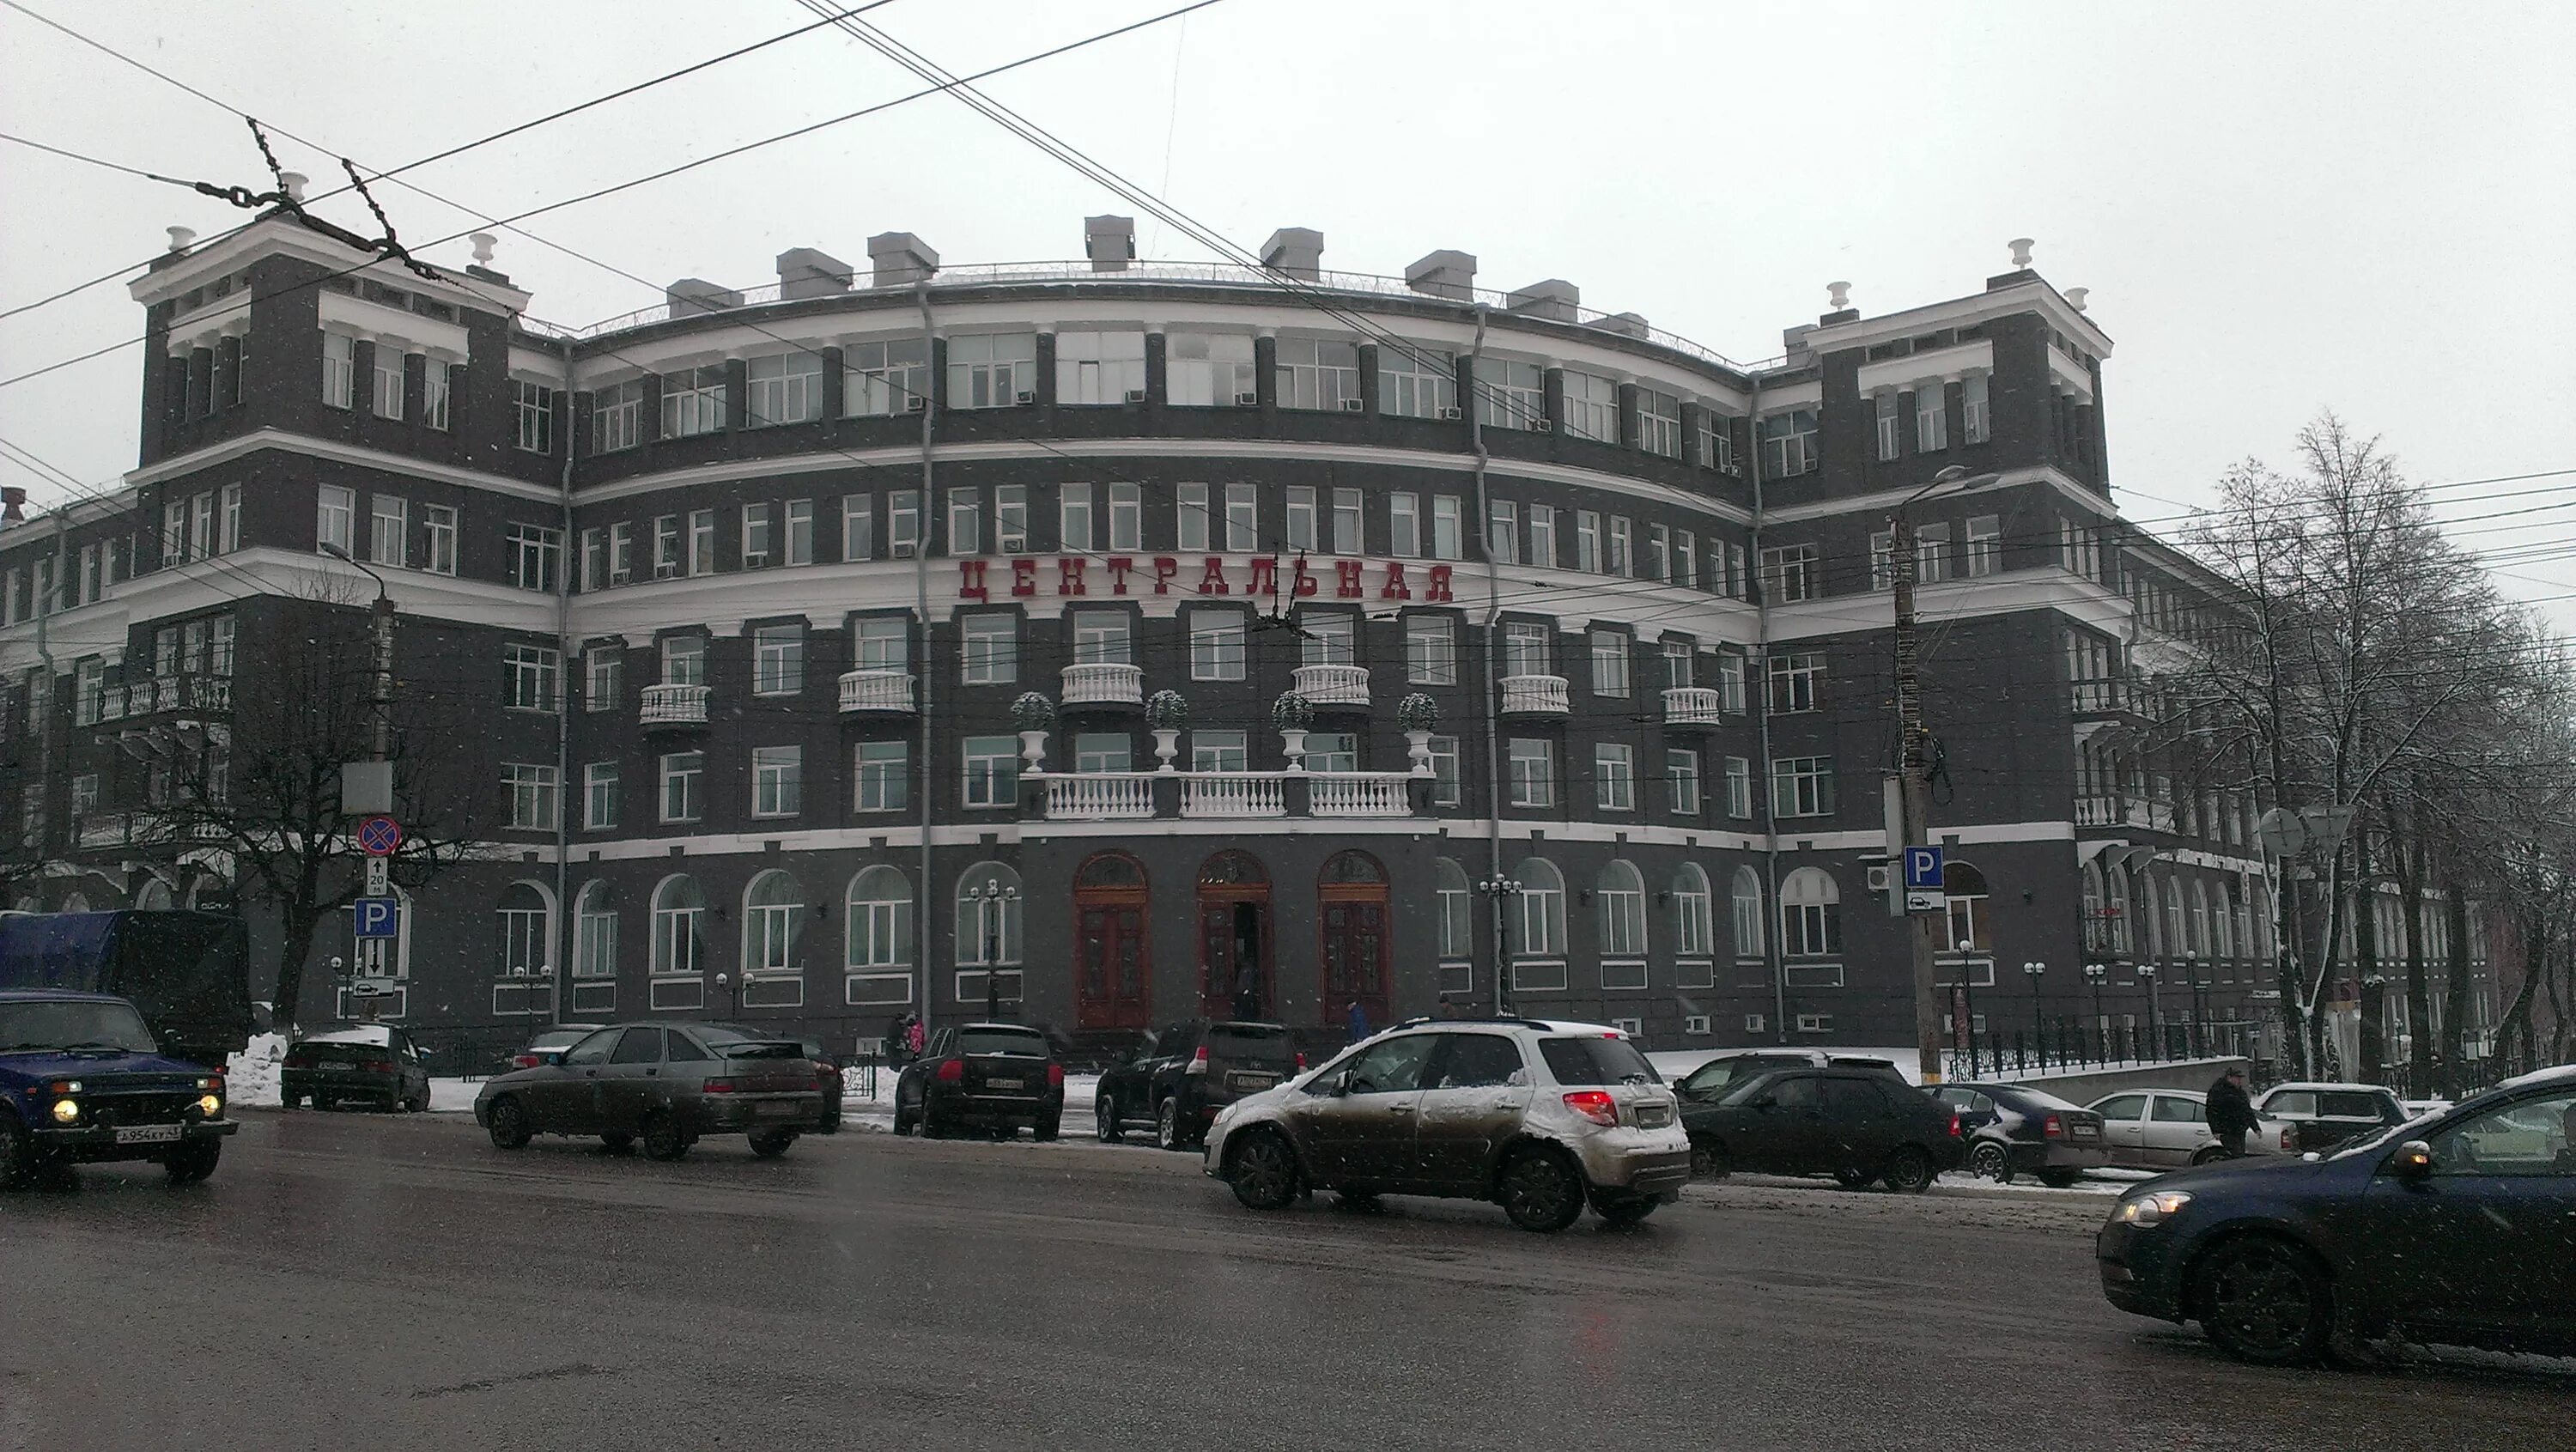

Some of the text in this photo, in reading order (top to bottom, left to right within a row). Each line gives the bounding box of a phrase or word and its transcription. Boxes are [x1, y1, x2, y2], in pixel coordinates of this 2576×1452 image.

[960, 557, 1455, 603] ЦЕНТРАЛЬНАЯ
[370, 875, 384, 885] 20
[1915, 851, 1935, 883] P
[365, 903, 387, 933] P
